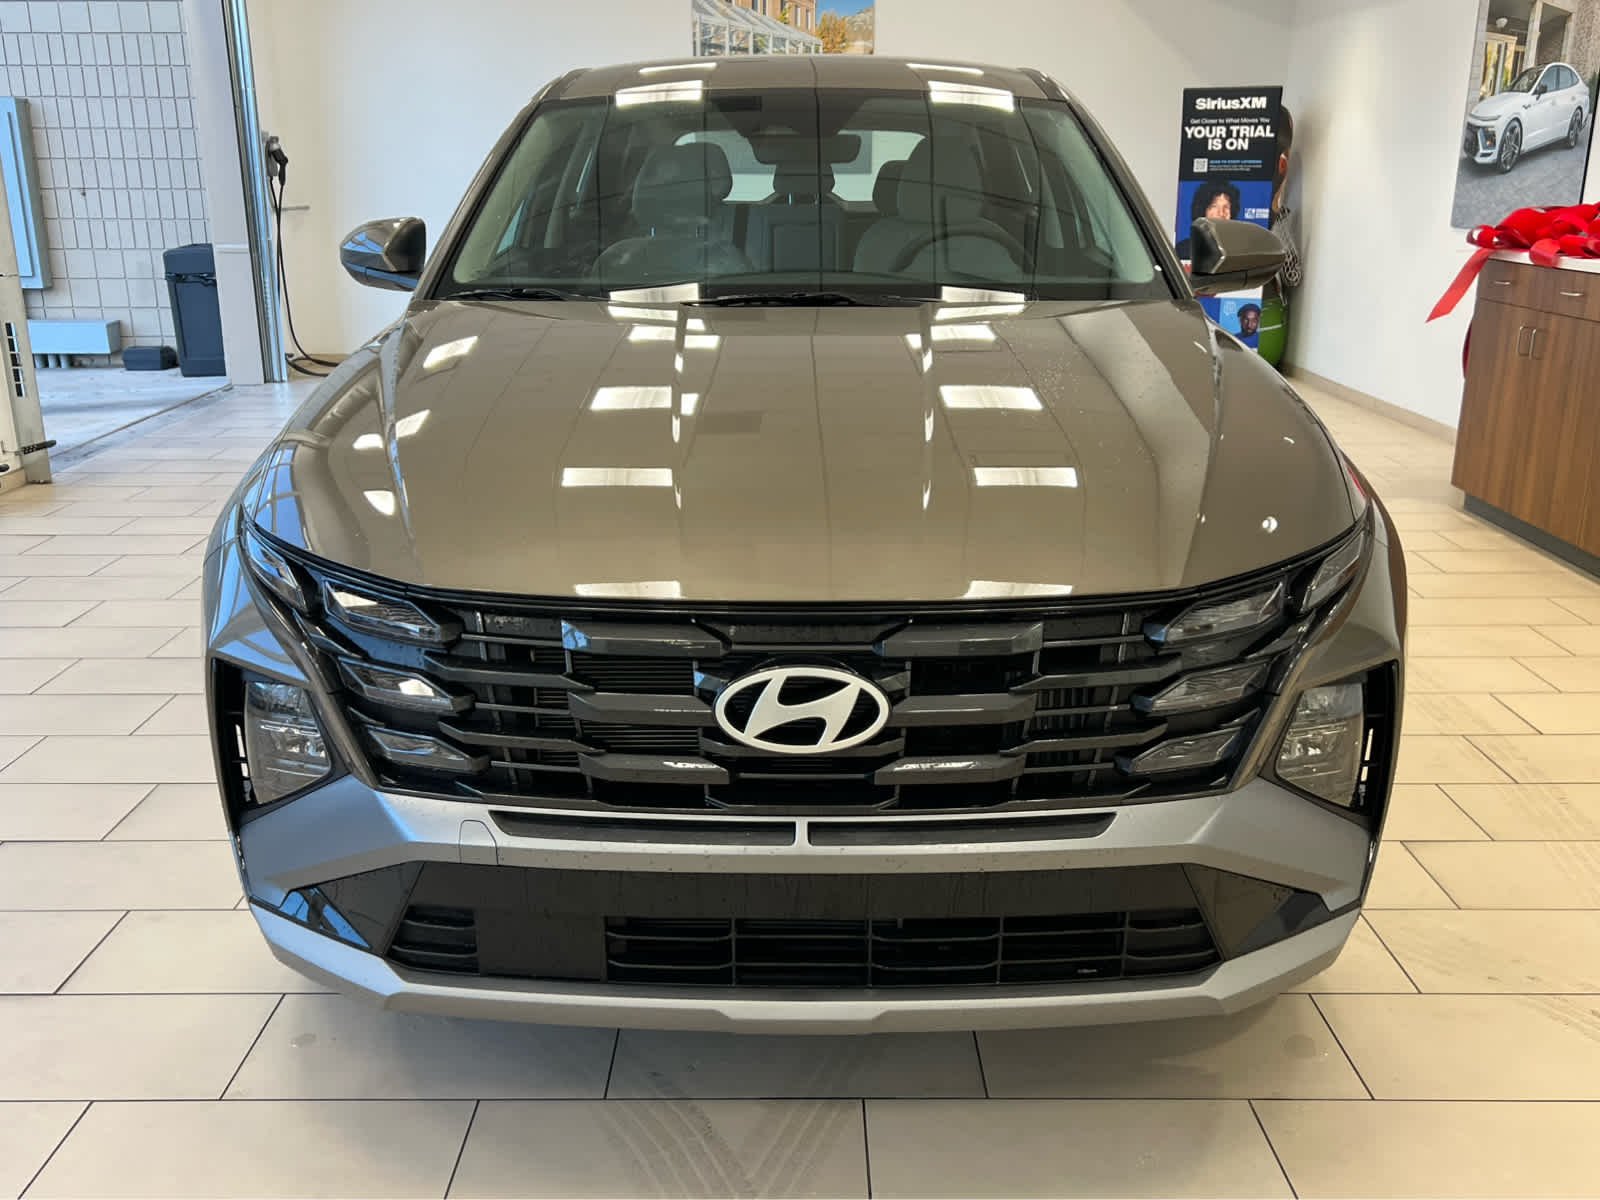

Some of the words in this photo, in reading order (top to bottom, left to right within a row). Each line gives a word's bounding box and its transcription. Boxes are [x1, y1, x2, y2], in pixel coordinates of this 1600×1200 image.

[1195, 96, 1267, 110] SiriusXM
[1185, 126, 1226, 138] YOUR
[1230, 125, 1275, 138] TRIAL
[1208, 138, 1222, 150] IS
[1225, 138, 1249, 150] ON
